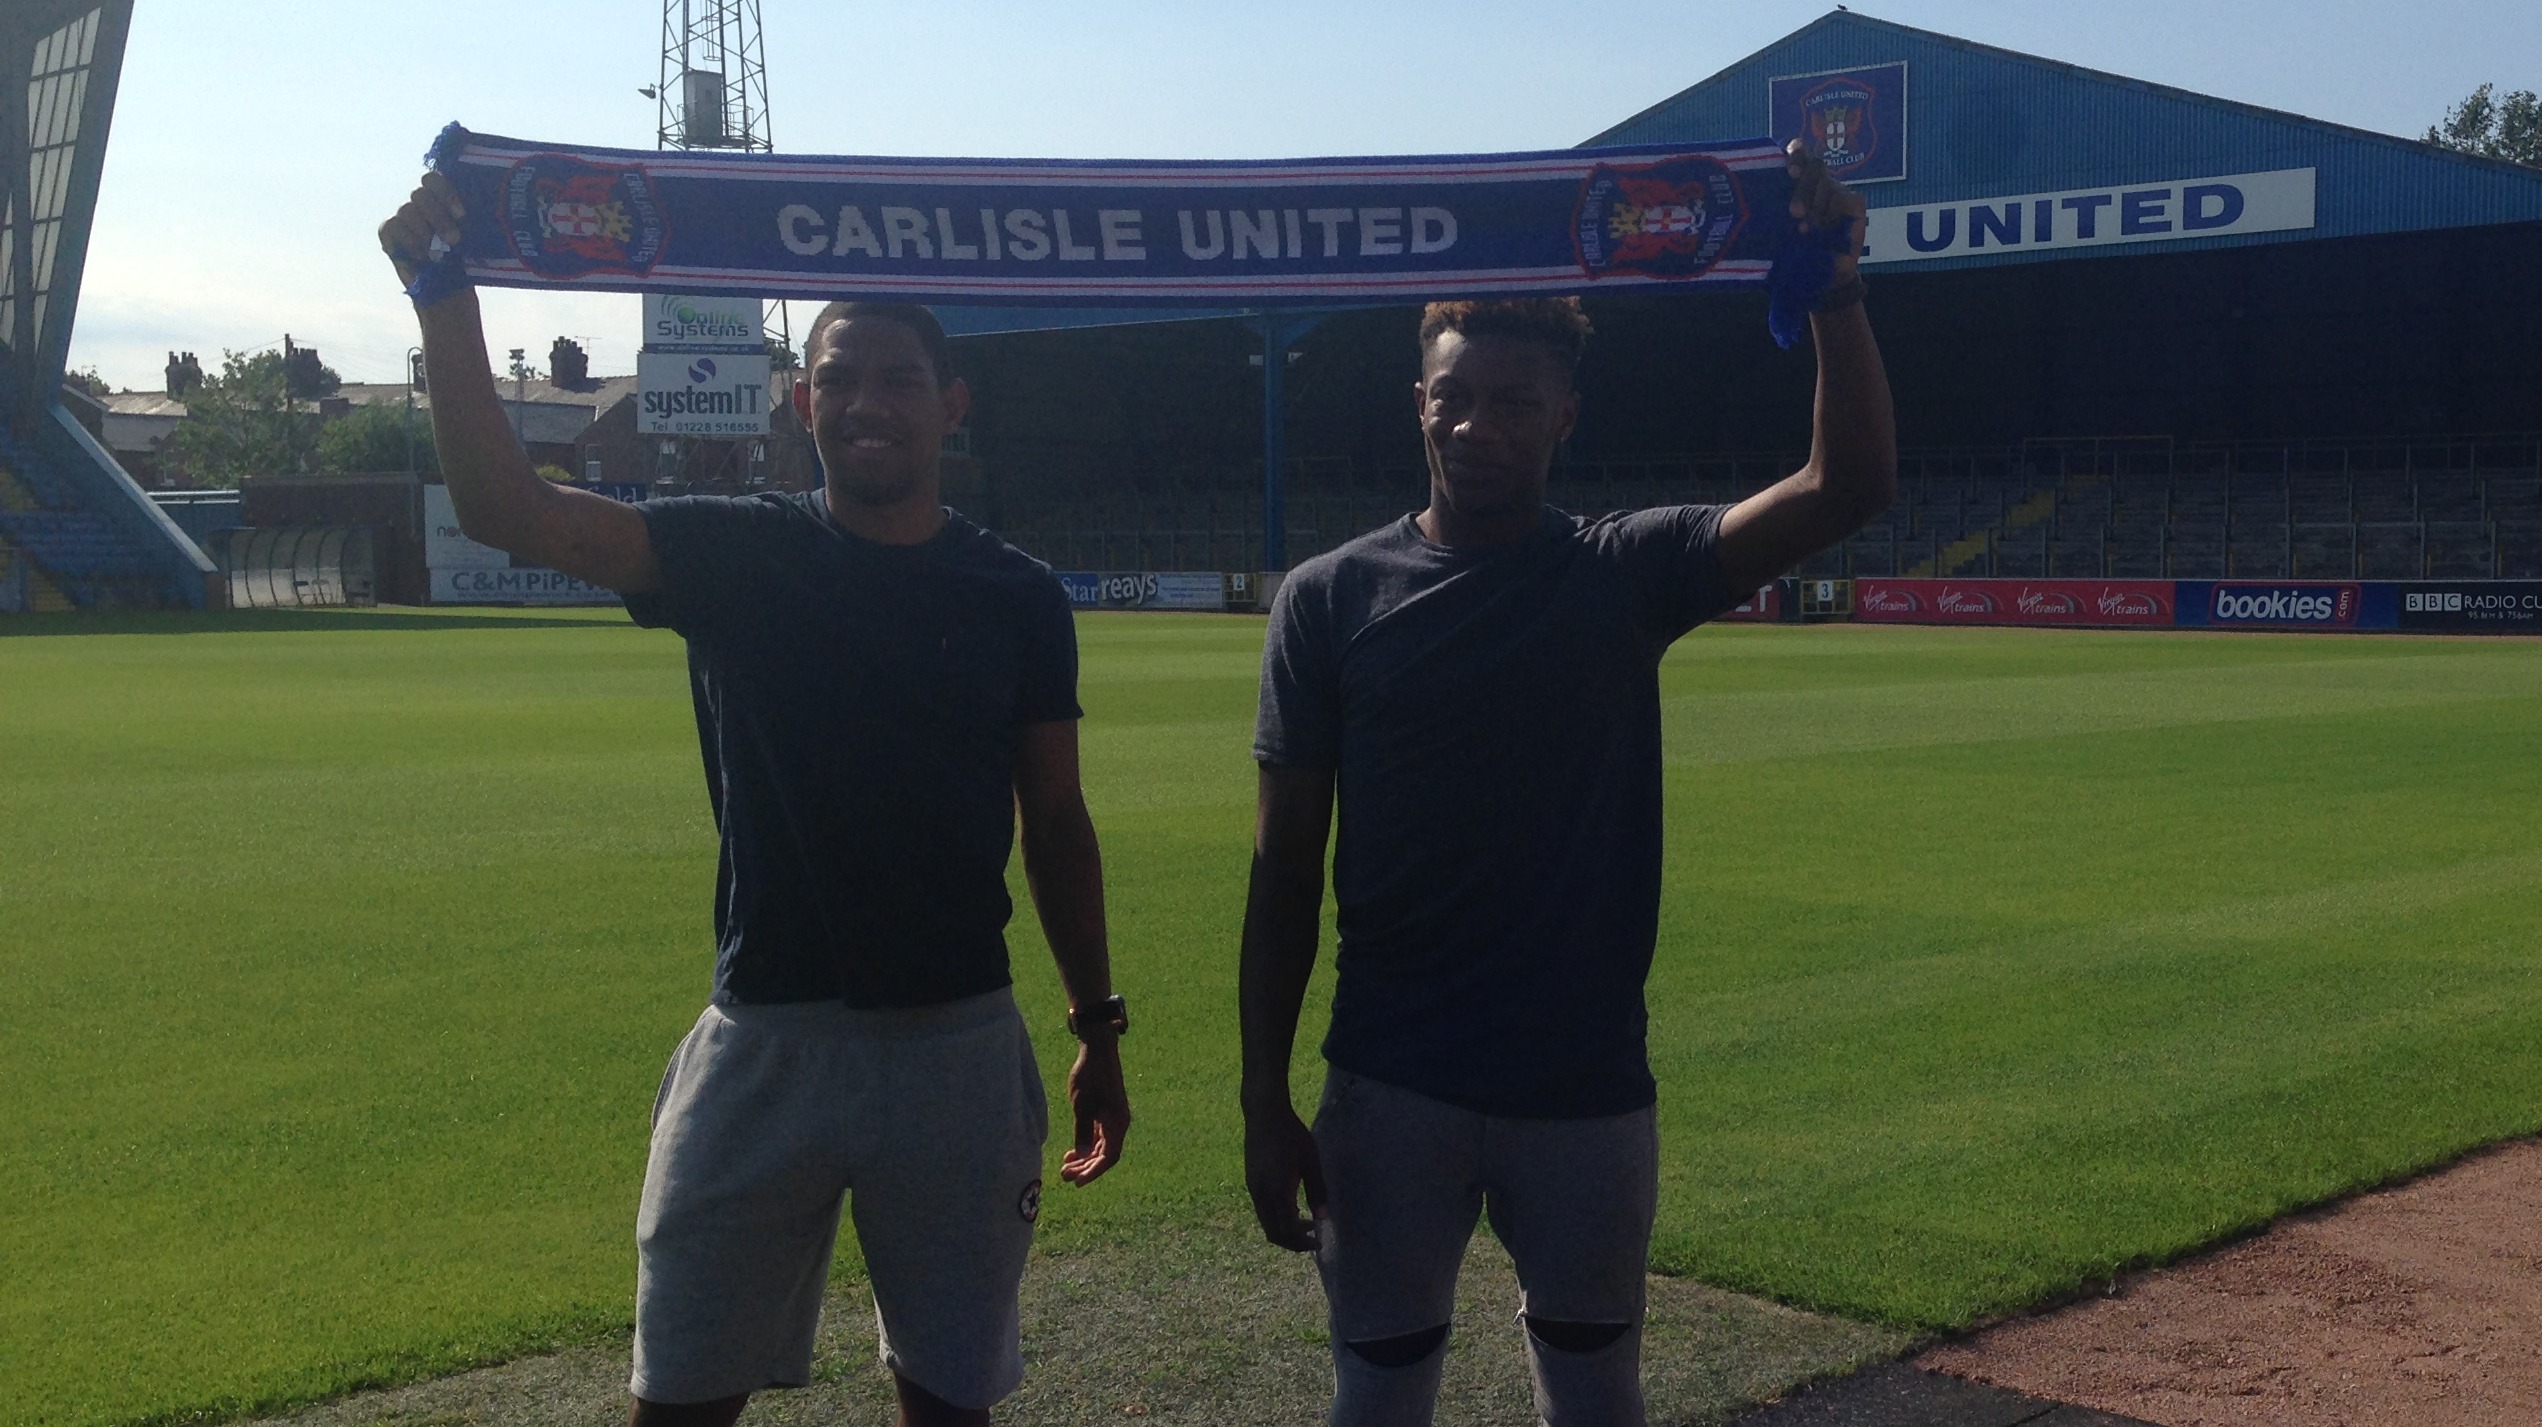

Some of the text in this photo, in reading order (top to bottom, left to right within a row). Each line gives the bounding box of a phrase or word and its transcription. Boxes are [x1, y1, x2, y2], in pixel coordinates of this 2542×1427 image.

[1906, 184, 2245, 253] UNITED
[778, 203, 1459, 262] CARLISLE UNITED
[657, 320, 749, 340] Systems
[651, 421, 668, 432] Tel
[676, 422, 711, 433] 01228
[451, 571, 520, 591] C&M
[1101, 573, 1157, 604] reays
[1236, 575, 1243, 590] 2
[1821, 583, 1829, 599] 3
[1863, 585, 1889, 612] Virgin
[1881, 602, 1909, 611] trains
[1936, 586, 1964, 614] Virgin
[1955, 603, 1985, 613] trains
[2017, 587, 2043, 614] Virgin
[2097, 587, 2126, 616] Virgin
[2217, 589, 2333, 620] bookies
[2407, 594, 2461, 611] BBC
[2464, 595, 2517, 609] RADIO
[2035, 604, 2066, 614] trains
[2117, 605, 2149, 615] trains
